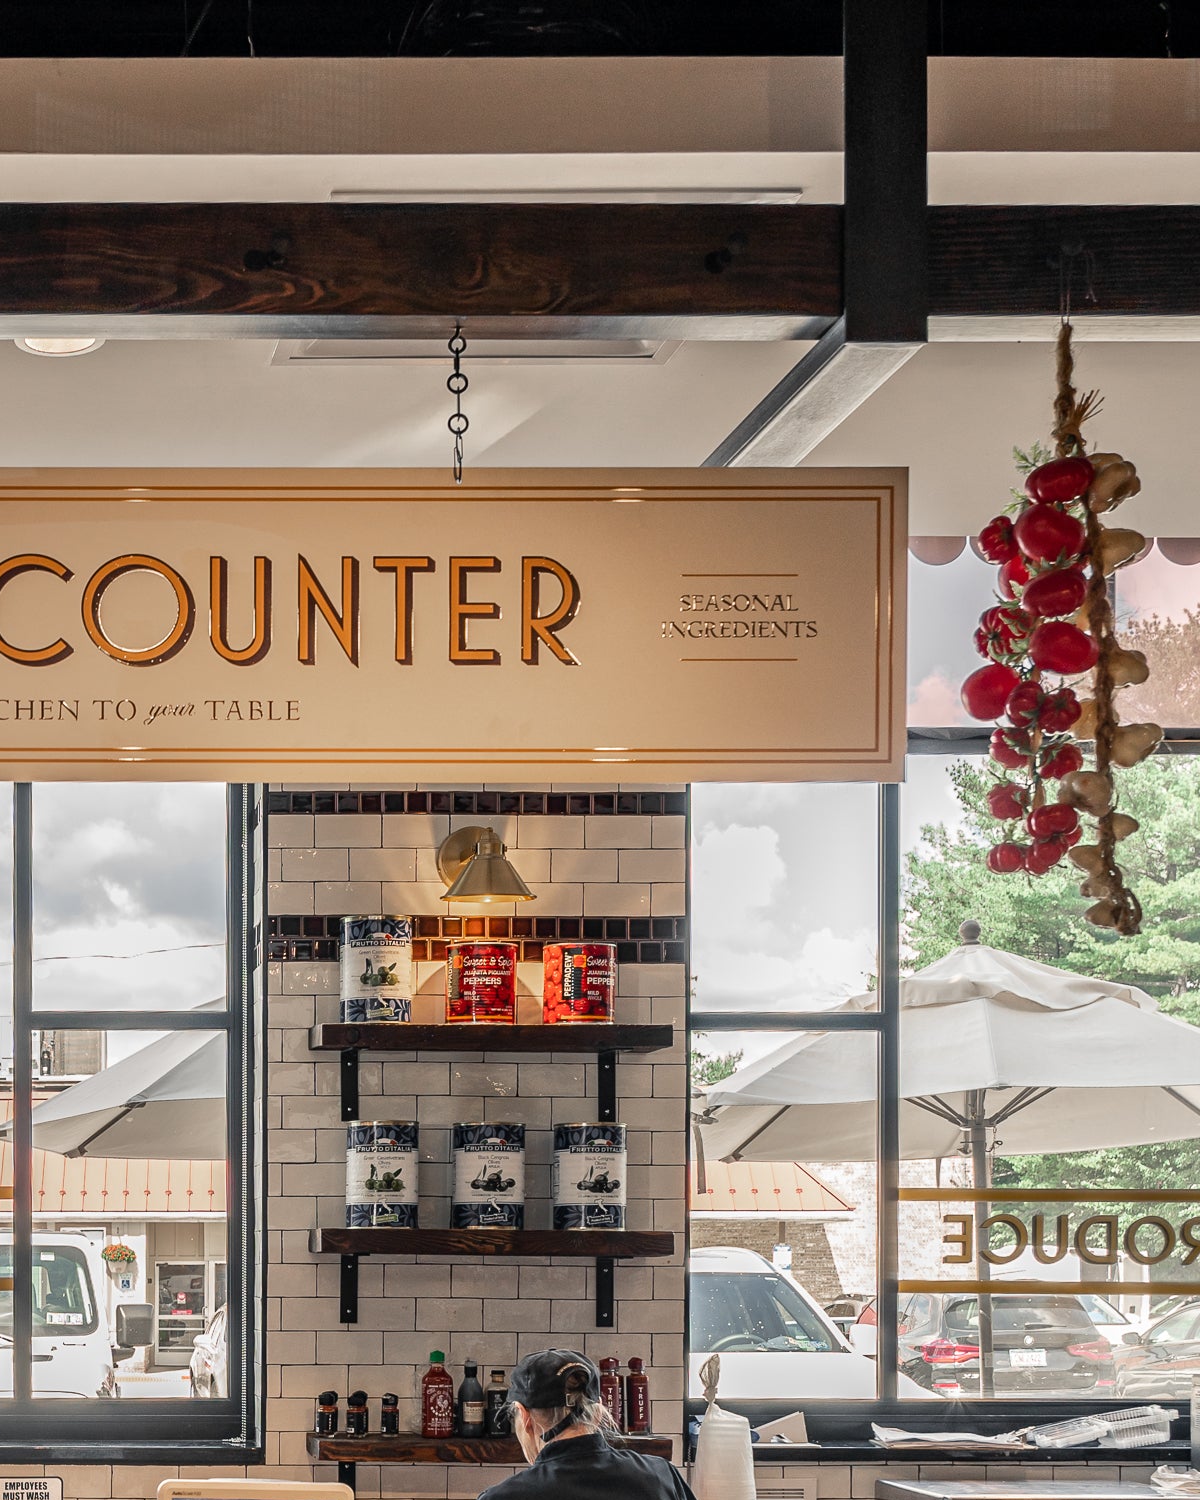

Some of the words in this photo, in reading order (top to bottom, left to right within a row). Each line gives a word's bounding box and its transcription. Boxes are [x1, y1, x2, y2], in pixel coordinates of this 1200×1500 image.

[679, 594, 799, 612] SEASONAL
[661, 619, 818, 639] INGREDIENTS
[94, 700, 137, 721] TO
[145, 699, 197, 725] your
[204, 700, 301, 721] TABLE
[463, 977, 502, 985] PEPPERS
[4, 1482, 48, 1490] EMPLOYEES
[2, 1492, 25, 1500] MUST
[26, 1491, 50, 1500] WASH
